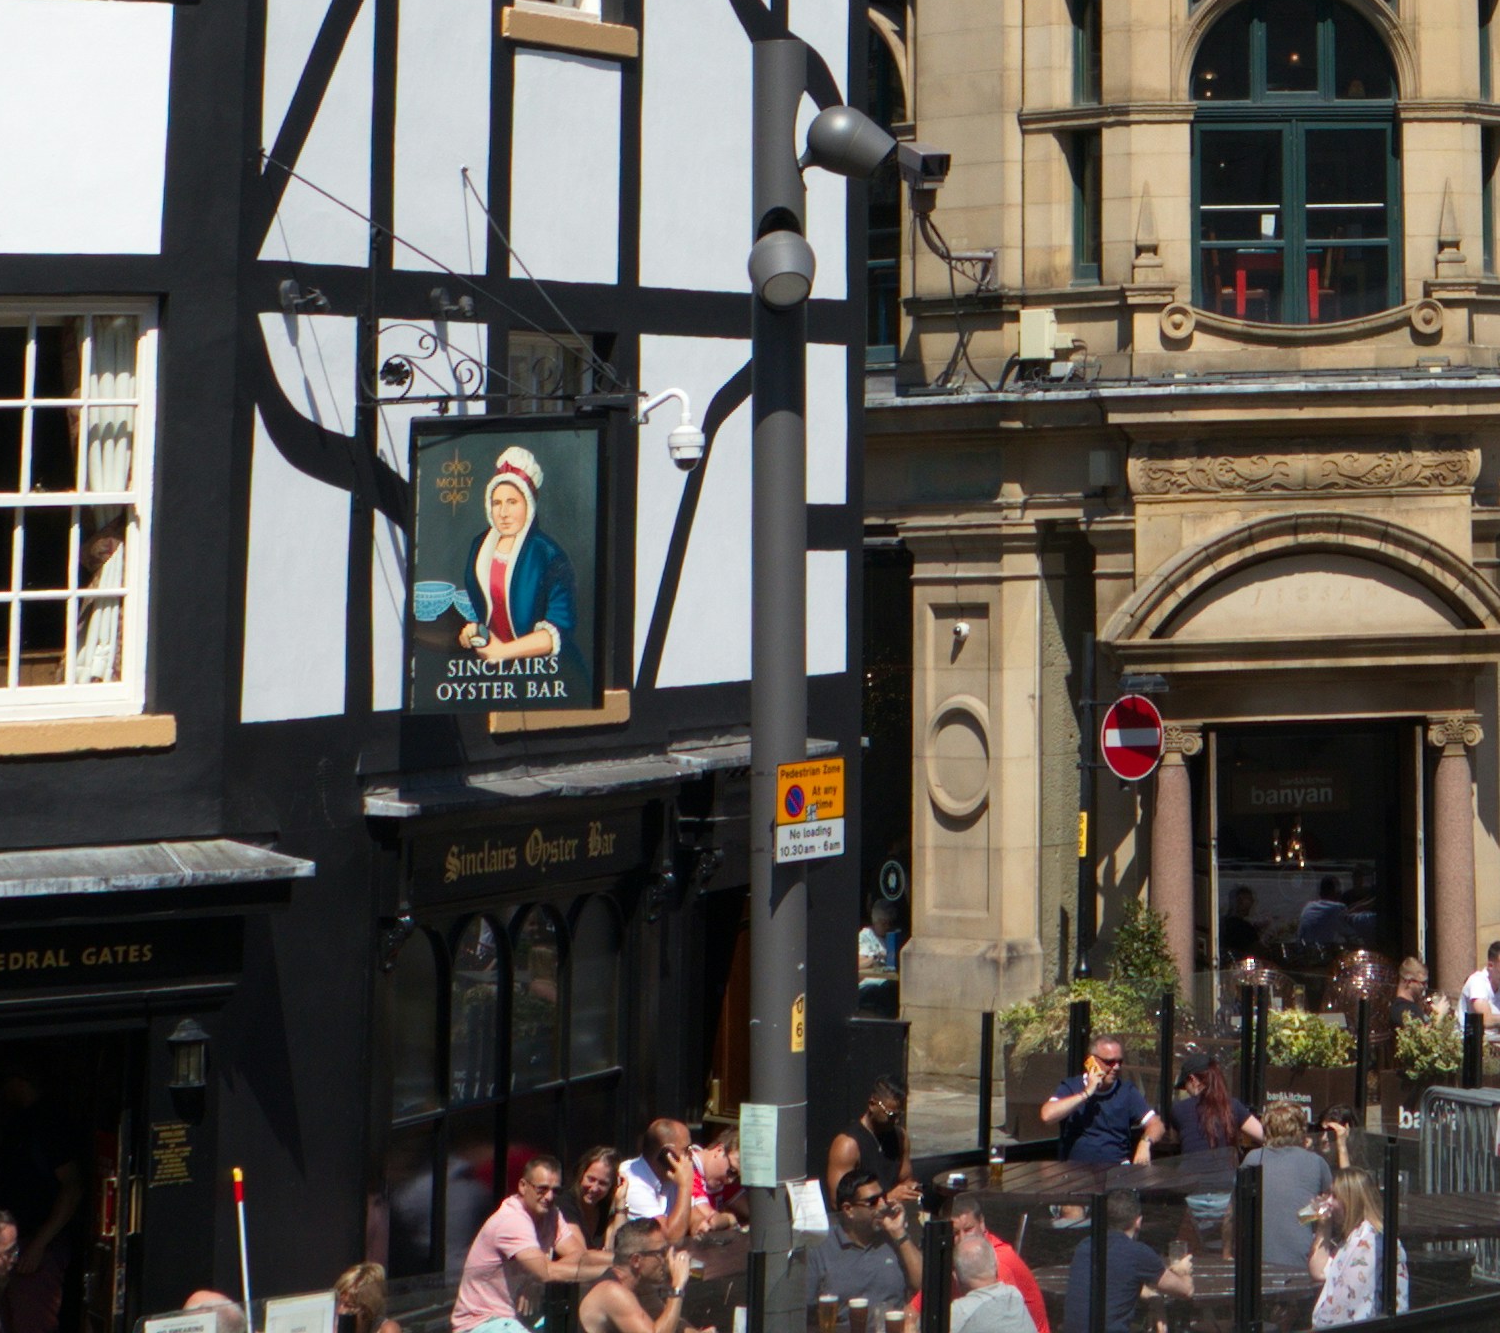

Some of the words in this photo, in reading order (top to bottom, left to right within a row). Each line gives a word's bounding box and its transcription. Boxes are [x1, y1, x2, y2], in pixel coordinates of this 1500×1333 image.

[436, 476, 474, 489] MOLLY
[447, 658, 560, 678] SINCLAIR'S
[436, 683, 517, 702] OYSTER
[526, 680, 569, 699] BAR
[780, 767, 821, 781] Pedestrian
[823, 764, 840, 775] Zone
[812, 786, 821, 796] At
[824, 785, 837, 796] any
[1251, 785, 1333, 808] banyan
[790, 829, 801, 840] No
[803, 826, 832, 837] loading
[444, 840, 517, 883] Sinclairs
[525, 828, 579, 872] Oyster
[587, 820, 617, 858] Bar
[780, 843, 816, 858] 10.30am
[823, 840, 841, 852] 6am
[82, 944, 153, 965] GATES
